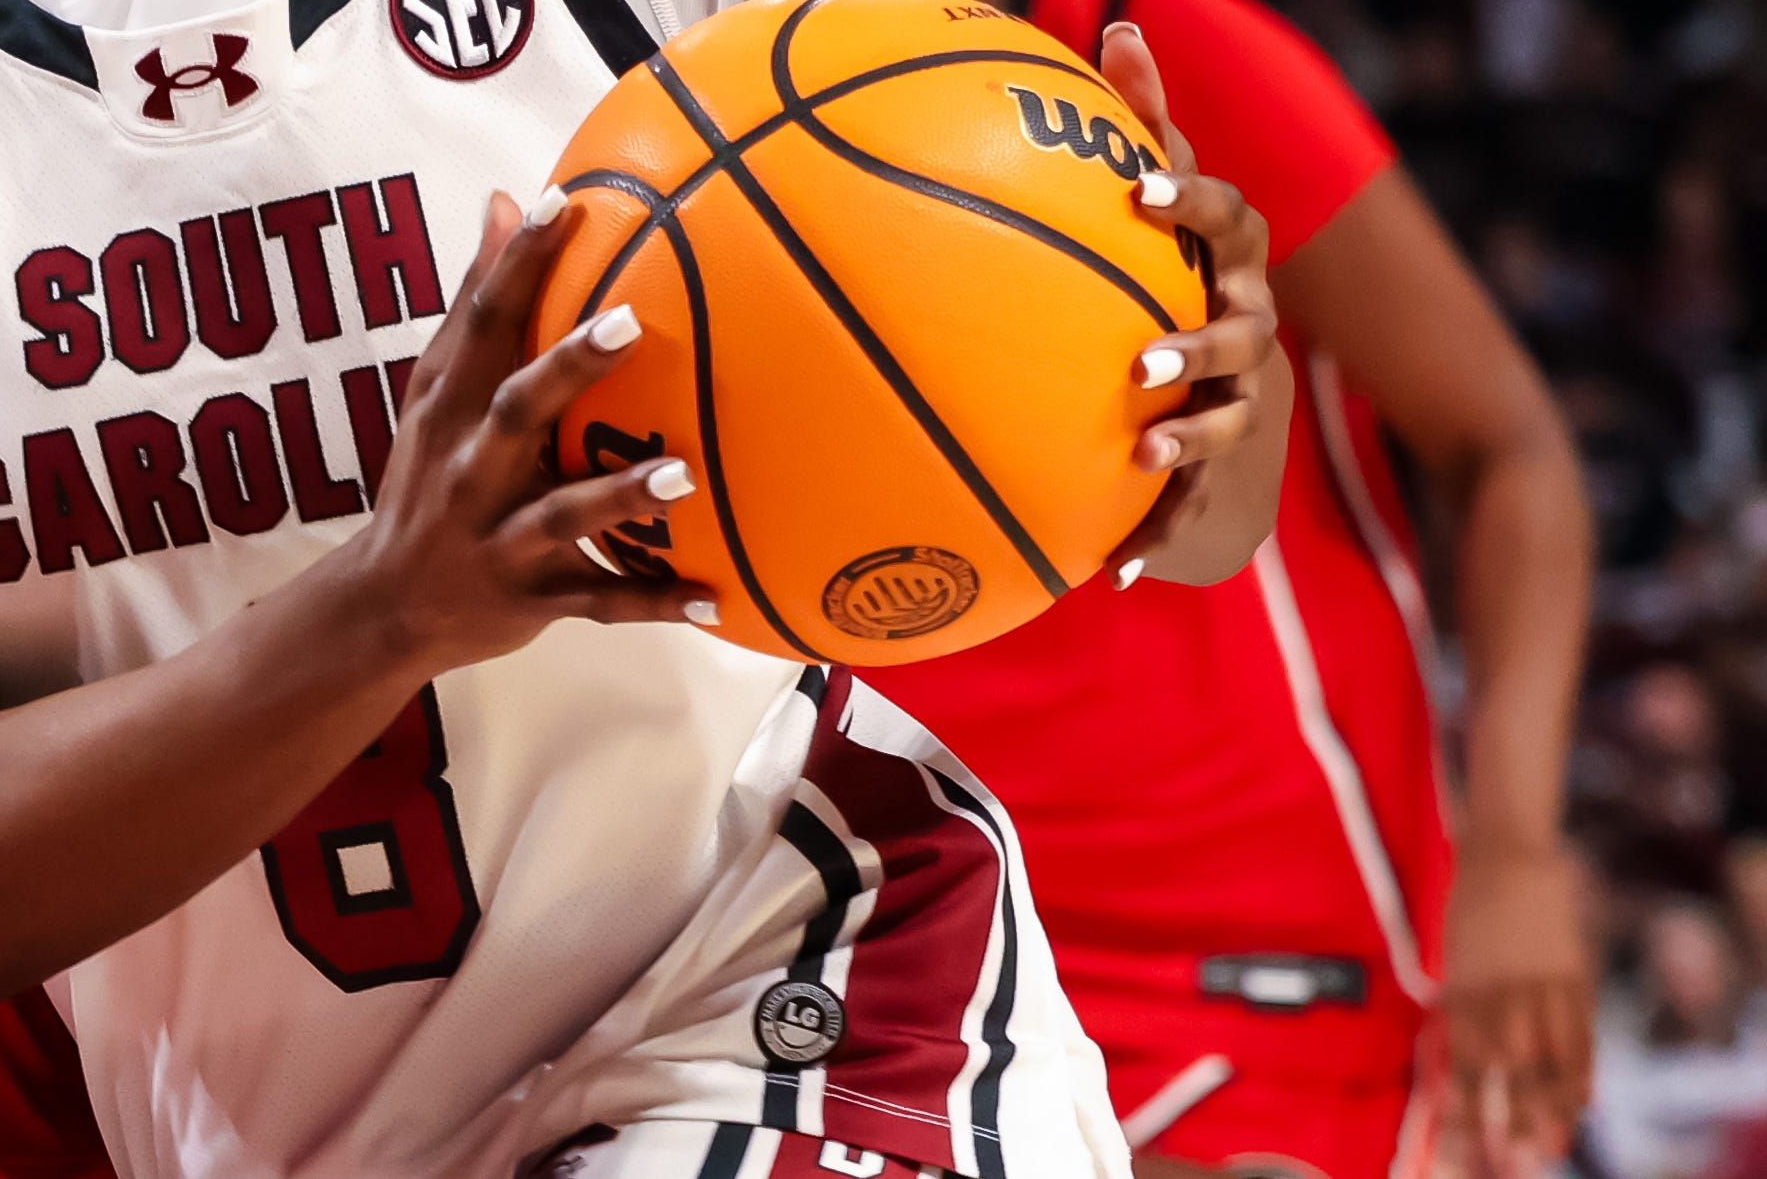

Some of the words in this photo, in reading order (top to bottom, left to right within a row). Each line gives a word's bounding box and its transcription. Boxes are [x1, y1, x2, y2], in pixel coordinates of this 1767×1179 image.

[14, 172, 446, 390] SOUTH
[259, 679, 482, 994] 8
[784, 1001, 822, 1029] LG
